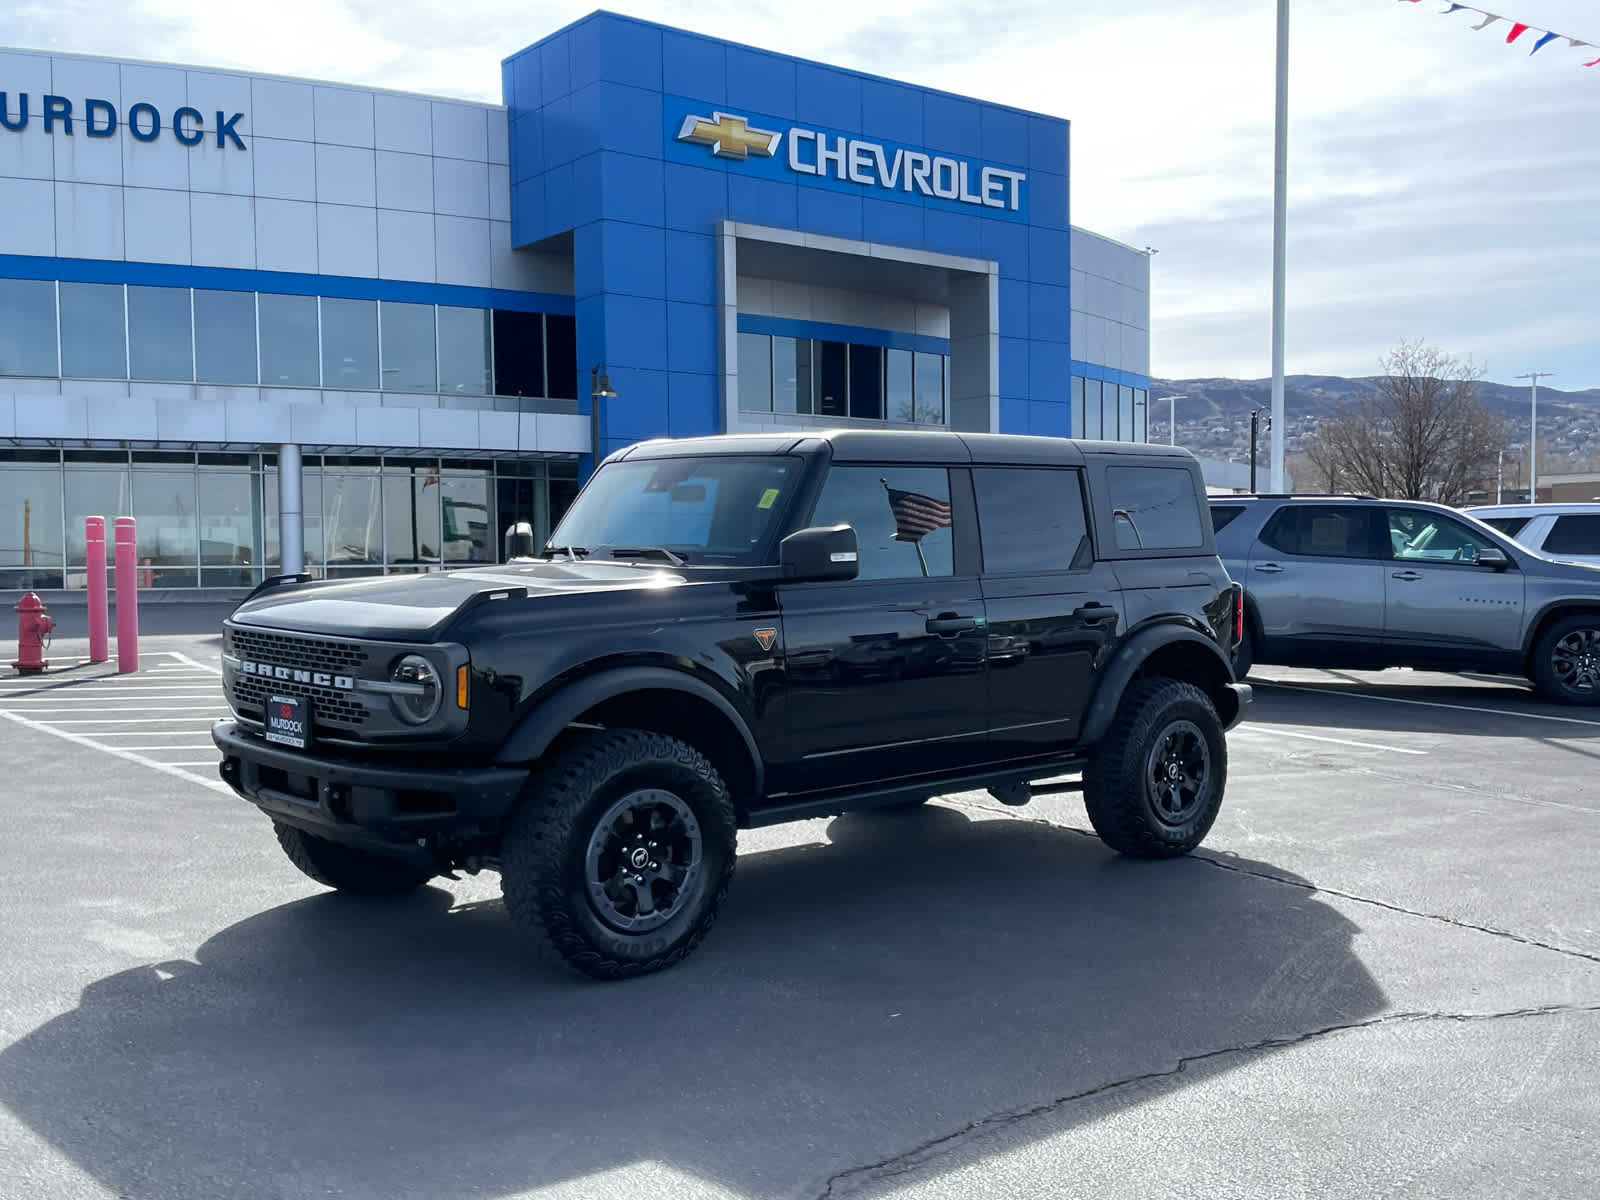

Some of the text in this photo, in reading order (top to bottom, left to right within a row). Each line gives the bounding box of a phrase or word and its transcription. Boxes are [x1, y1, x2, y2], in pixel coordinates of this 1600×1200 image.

[788, 127, 1026, 211] CHEVROLET
[242, 660, 353, 689] BRONCO
[270, 716, 303, 733] MURDOCK
